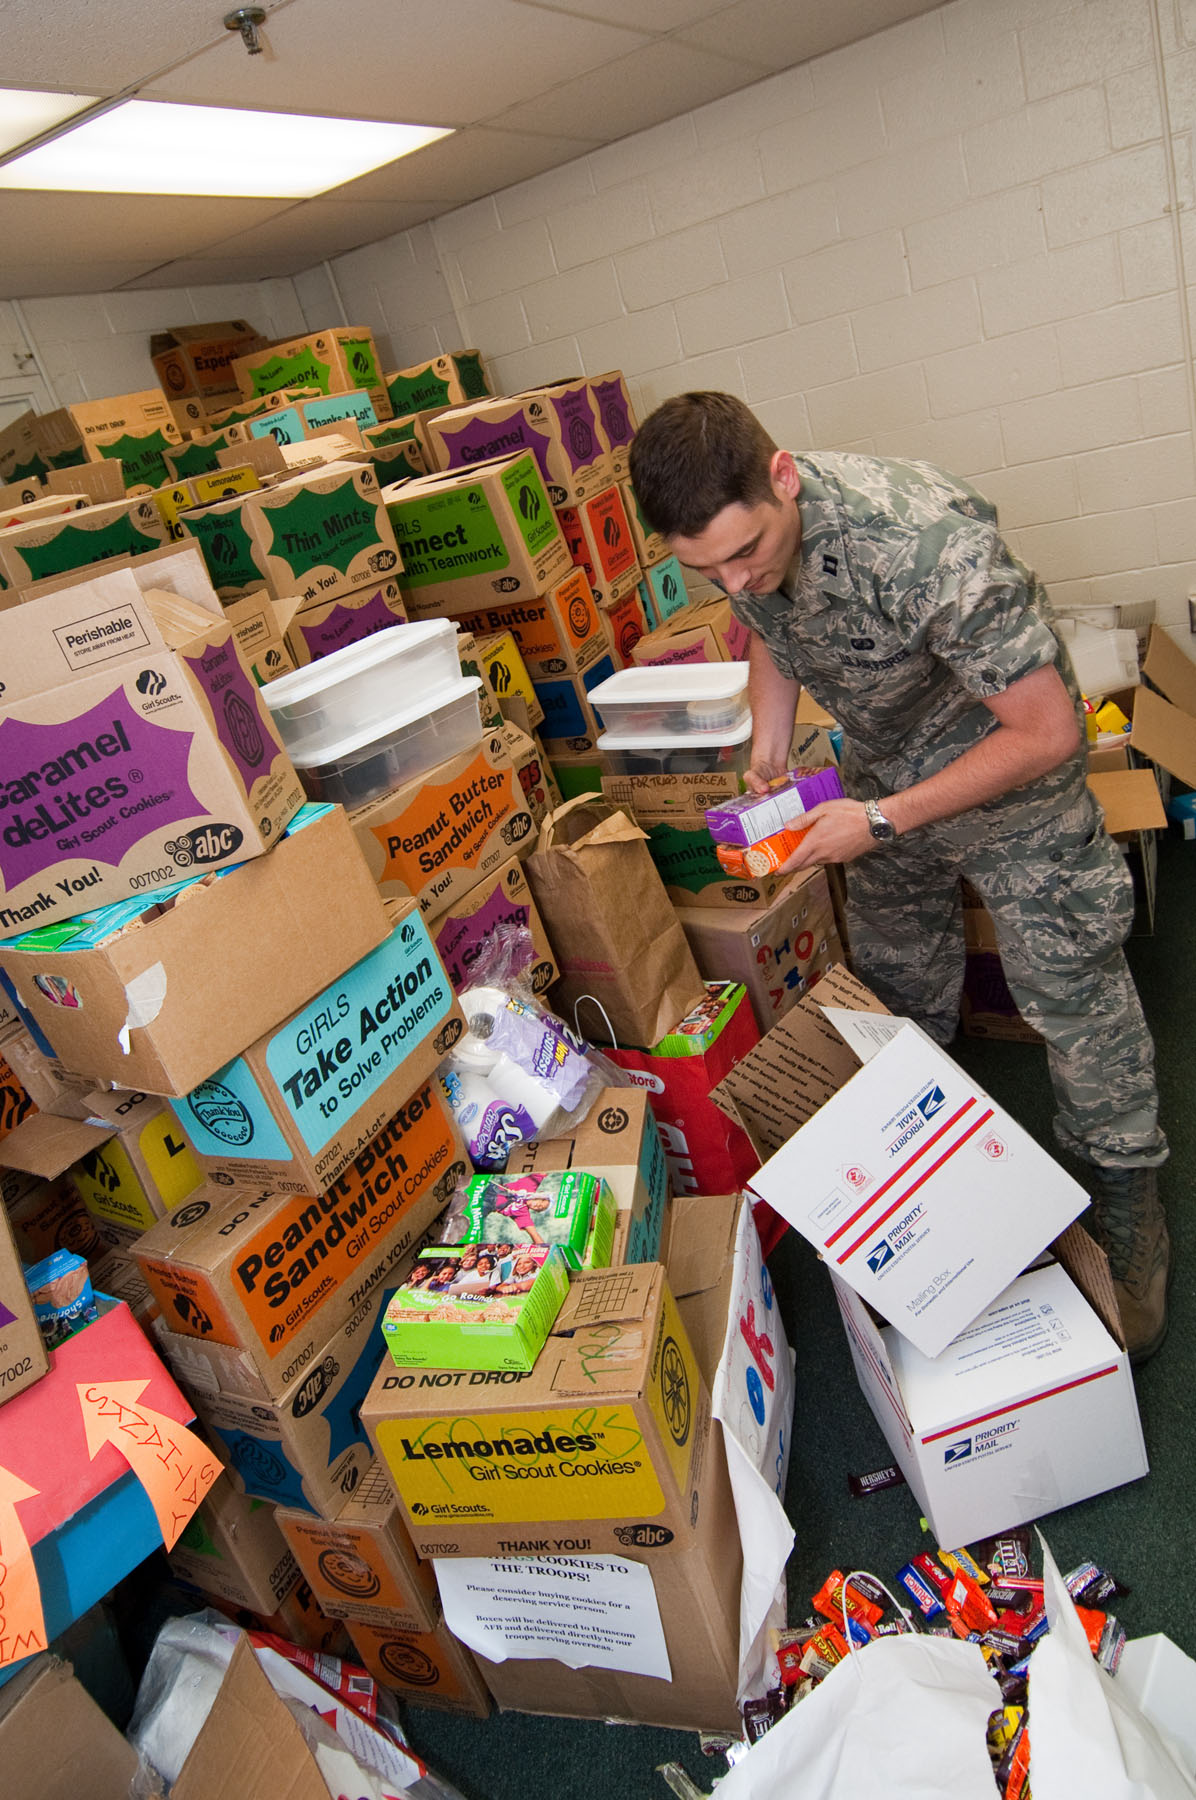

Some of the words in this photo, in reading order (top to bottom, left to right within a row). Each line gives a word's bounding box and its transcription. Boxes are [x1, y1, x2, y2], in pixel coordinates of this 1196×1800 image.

[96, 423, 108, 431] NOT
[110, 420, 126, 429] DROP
[461, 426, 525, 464] Caramel
[281, 531, 322, 555] Thin
[322, 509, 371, 540] Mints
[400, 524, 468, 559] nnect
[379, 552, 394, 569] abc
[428, 543, 503, 572] Teamwork
[316, 572, 338, 591] You!
[502, 579, 518, 590] abc
[487, 607, 547, 628] Butter
[65, 616, 133, 649] Perishable
[73, 647, 91, 657] STORE
[90, 642, 105, 652] AWAY
[104, 637, 120, 647] FROM
[120, 630, 136, 642] HEAT
[871, 648, 911, 671] FORCE
[141, 700, 156, 712] Girl
[630, 775, 649, 791] FOR
[387, 812, 450, 859] Peanut
[449, 772, 505, 816] Butter
[512, 815, 528, 838] abc
[56, 835, 81, 851] Girl
[81, 816, 118, 843] Scout
[194, 826, 231, 858] abc
[418, 802, 493, 873] Sandwich
[463, 849, 474, 861] Girl
[473, 831, 489, 852] Scout
[481, 850, 500, 871] 007007
[130, 866, 175, 890] 007002
[430, 871, 453, 898] You!
[0, 892, 56, 928] Thank
[56, 866, 103, 896] You!
[736, 886, 755, 900] abc
[534, 964, 551, 989] abc
[283, 1038, 352, 1110] Take
[360, 957, 433, 1046] Action
[297, 994, 350, 1055] GIRLS
[442, 1019, 461, 1052] abc
[319, 1095, 339, 1120] to
[338, 1053, 382, 1099] Solve
[381, 987, 443, 1055] Problems
[778, 1054, 798, 1070] Priority
[115, 1092, 147, 1115] DO
[200, 1104, 222, 1120] Thank
[221, 1103, 243, 1118] You
[895, 1108, 918, 1131] MAIL
[314, 1142, 343, 1175] 007021
[236, 1180, 351, 1293] Peanut
[350, 1087, 433, 1179] Butter
[277, 1181, 309, 1194] 007021
[474, 1181, 484, 1204] Thin
[219, 1210, 242, 1236] DO
[264, 1151, 409, 1309] Sandwich
[346, 1232, 372, 1259] Girl
[367, 1193, 406, 1236] Scout
[469, 1204, 481, 1238] Mints
[894, 1229, 917, 1252] MAIL
[348, 1260, 387, 1308] THANK
[384, 1233, 412, 1273] YOU!
[906, 1282, 936, 1312] Mailing
[933, 1269, 952, 1288] Box
[285, 1302, 306, 1325] Girl
[345, 1301, 372, 1338] 007005
[0, 1357, 33, 1386] 7002
[281, 1341, 316, 1384] 007007
[382, 1376, 417, 1390] DO
[418, 1373, 465, 1388] NOT
[467, 1371, 533, 1385] DROP
[297, 1374, 323, 1413] abc
[402, 1407, 643, 1495] TROOPS
[975, 1440, 998, 1454] MAIL
[469, 1465, 502, 1482] Girl
[505, 1463, 557, 1481] Scout
[860, 1467, 896, 1487] HERSHEY'S
[430, 1504, 449, 1514] Girl
[498, 1540, 549, 1552] THANK
[551, 1538, 592, 1551] YOU!
[635, 1528, 666, 1544] abc
[420, 1544, 460, 1555] 007022
[491, 1563, 524, 1574] THE
[526, 1565, 591, 1582] TROOPS!
[536, 1555, 605, 1571] COOKIES
[606, 1563, 629, 1575] TO
[466, 1584, 496, 1593] Please
[497, 1587, 537, 1597] consider
[538, 1590, 571, 1602] buying
[571, 1594, 607, 1607] cookies
[608, 1600, 623, 1610] for
[903, 1573, 937, 1609] CRUNCH
[492, 1594, 538, 1606] deserving
[538, 1600, 571, 1609] service
[572, 1604, 608, 1615] person.
[483, 1623, 503, 1631] AFB
[504, 1624, 522, 1632] and
[523, 1625, 566, 1637] delivered
[567, 1630, 603, 1643] directly
[604, 1635, 614, 1644] to
[615, 1639, 633, 1647] our
[523, 1616, 535, 1624] be
[536, 1618, 579, 1630] delivered
[580, 1623, 591, 1632] to
[591, 1625, 636, 1639] Hanscom
[505, 1633, 536, 1641] troops
[536, 1635, 571, 1646] serving
[571, 1639, 615, 1652] overseas.
